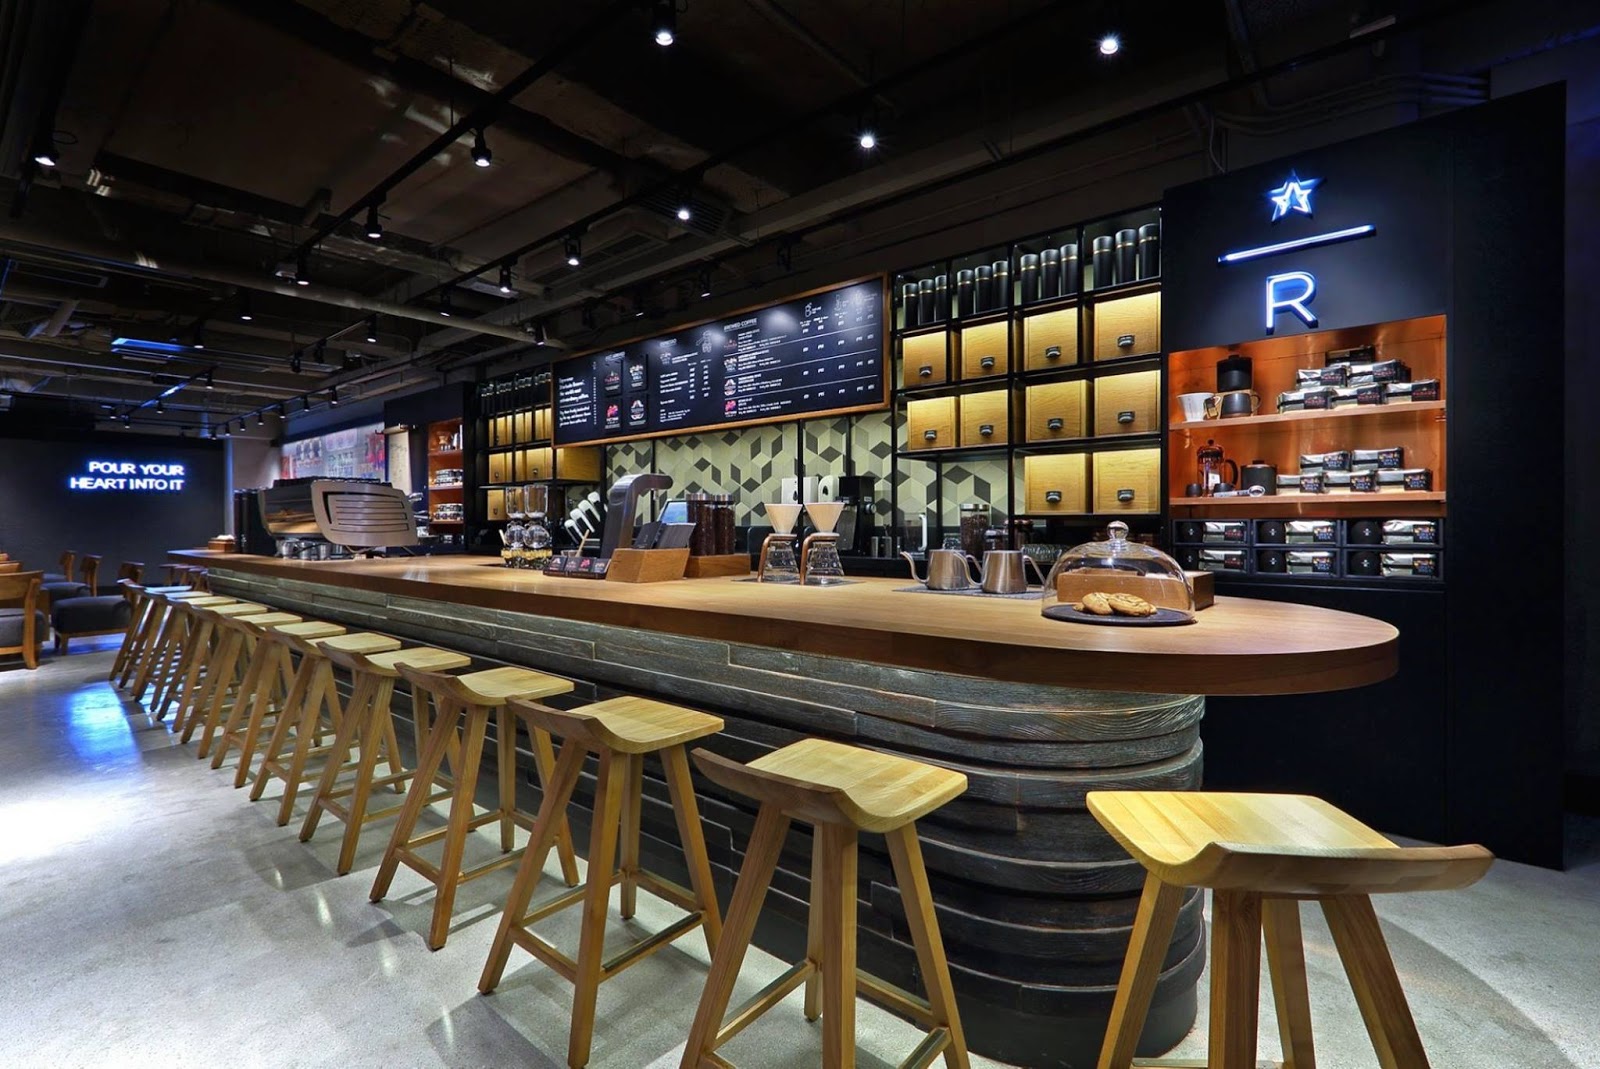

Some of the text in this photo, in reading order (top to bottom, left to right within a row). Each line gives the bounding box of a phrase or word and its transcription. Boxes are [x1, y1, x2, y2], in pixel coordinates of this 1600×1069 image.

[1265, 271, 1318, 334] R
[88, 461, 185, 476] POUR YOUR
[69, 477, 185, 491] HEART INTO IT
